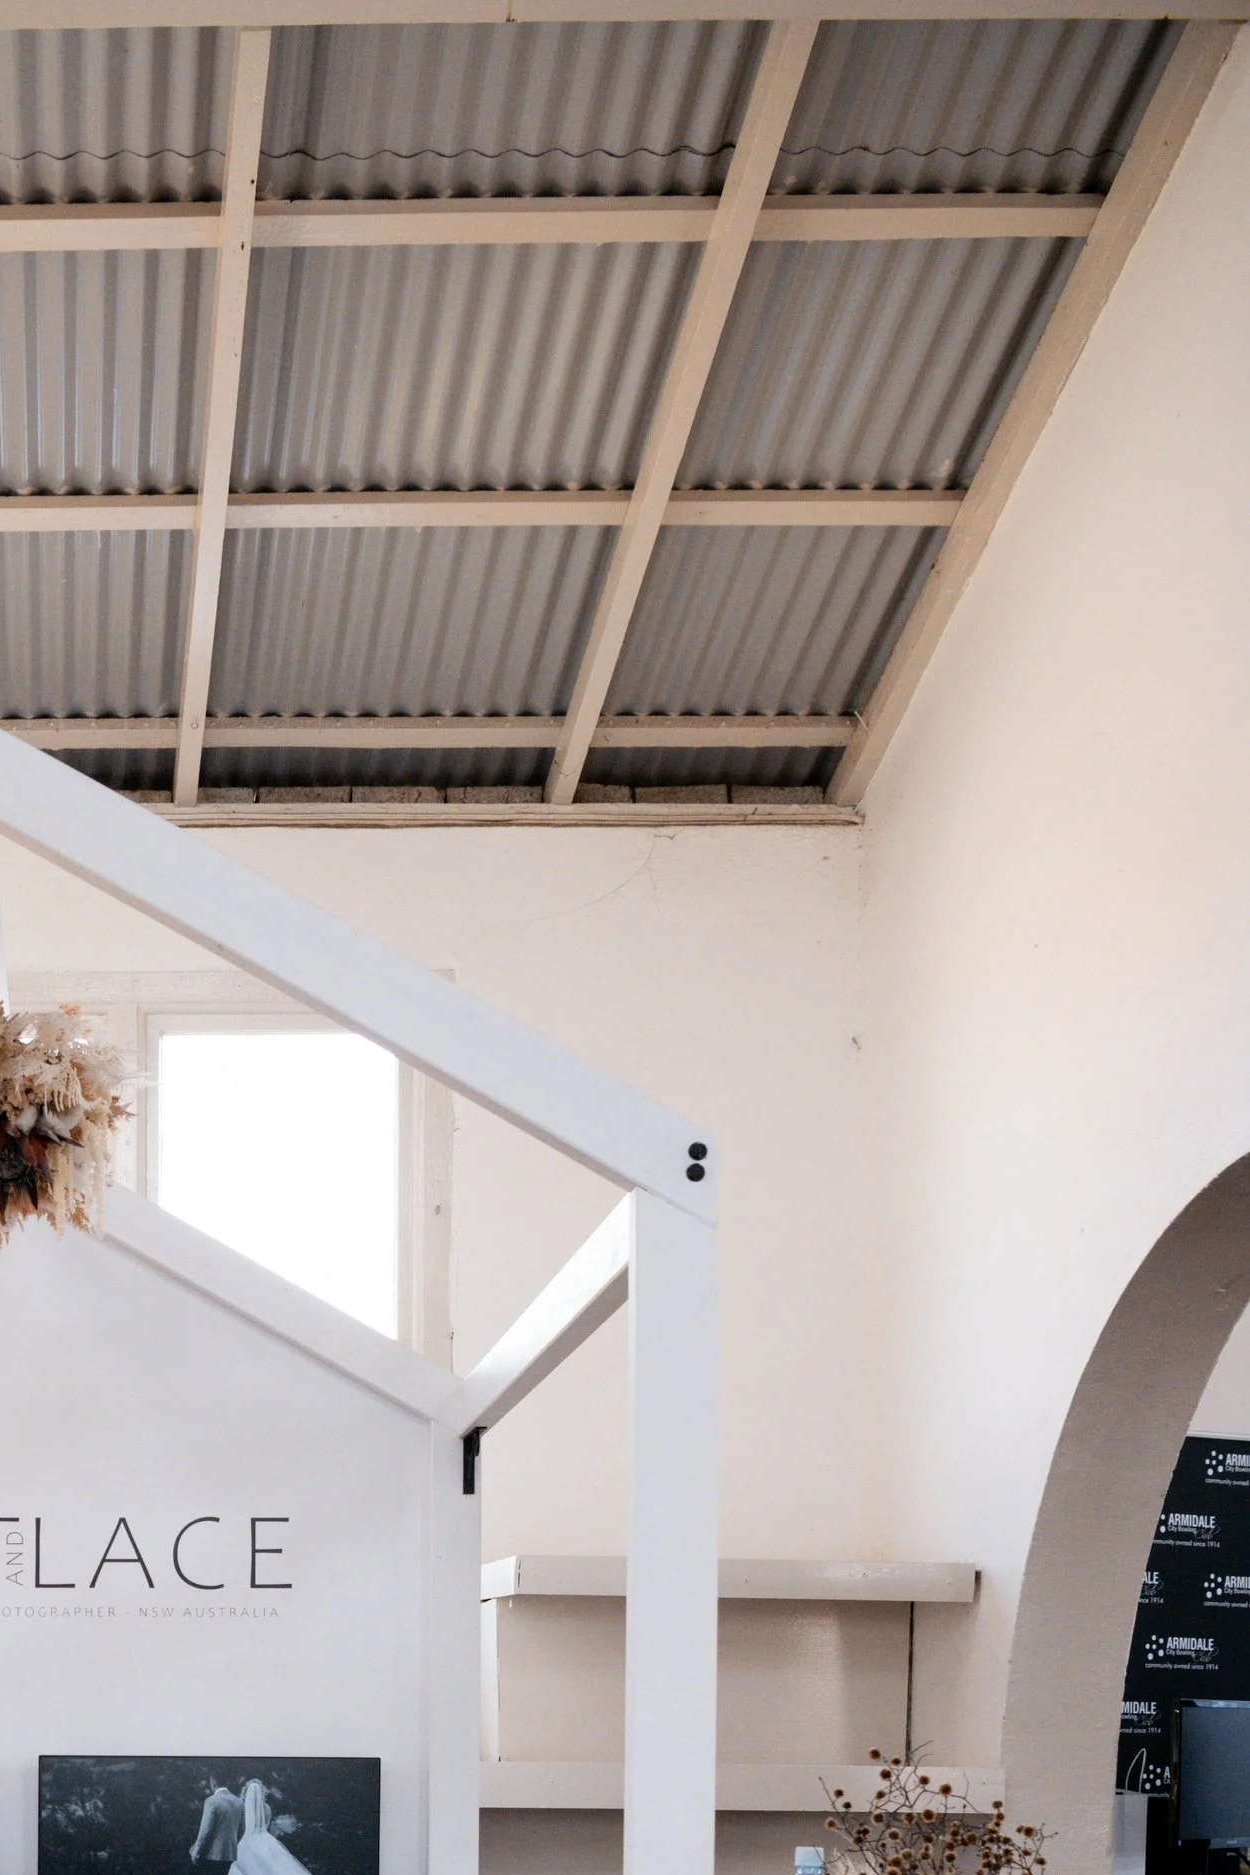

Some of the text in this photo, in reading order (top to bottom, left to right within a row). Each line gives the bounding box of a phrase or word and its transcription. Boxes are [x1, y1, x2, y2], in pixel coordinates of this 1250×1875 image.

[1225, 1454, 1250, 1466] ARMI
[1168, 1513, 1216, 1528] ARMIDALE
[1178, 1526, 1196, 1534] Bowling
[5, 1530, 24, 1586] AND
[1224, 1576, 1250, 1588] ARMI
[139, 1606, 174, 1618] NSW
[182, 1606, 279, 1618] AUSTRALIA
[1166, 1637, 1214, 1651] ARMIDALE
[1176, 1649, 1196, 1658] Bowling
[1145, 1662, 1172, 1670] community
[1122, 1701, 1157, 1714] MIDALE
